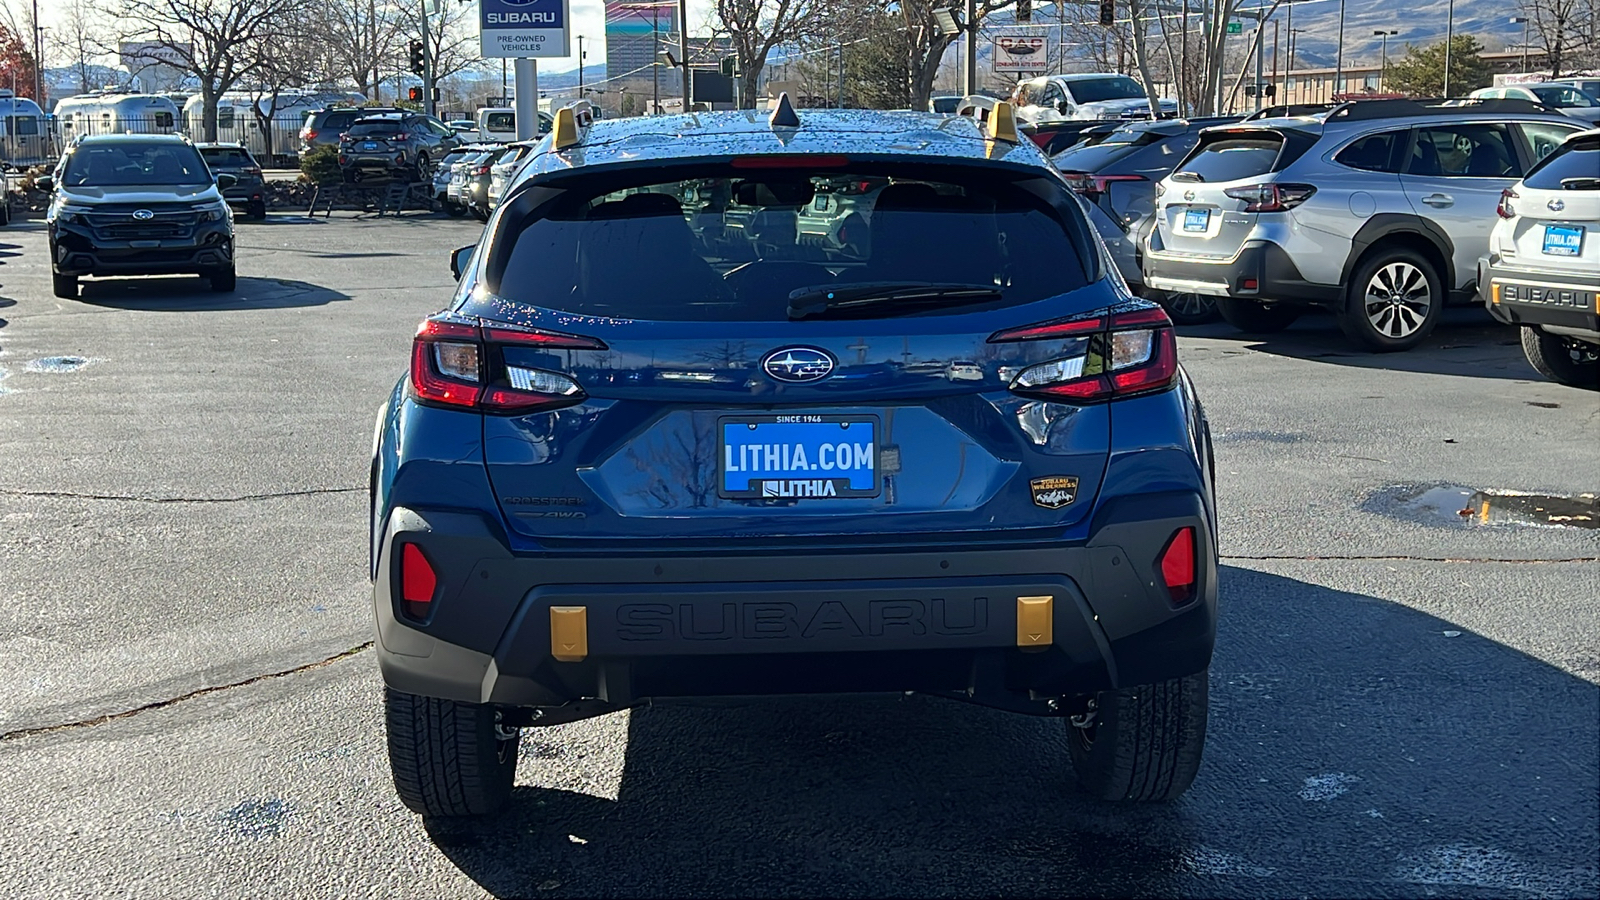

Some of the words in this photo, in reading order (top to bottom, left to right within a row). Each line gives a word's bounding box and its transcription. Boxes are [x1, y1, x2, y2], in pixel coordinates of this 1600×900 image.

[487, 12, 556, 24] SUBARU
[497, 35, 546, 43] PRE-OWNED
[502, 43, 541, 51] VEHICLES
[1504, 285, 1589, 309] SUBARU
[776, 415, 801, 423] SINCE
[803, 415, 822, 423] 1946
[725, 442, 874, 472] LITHIA.COM
[780, 480, 837, 497] LITHIA
[503, 496, 585, 506] CROSSTREK
[543, 511, 587, 519] AWD
[616, 597, 989, 641] SUBARU
